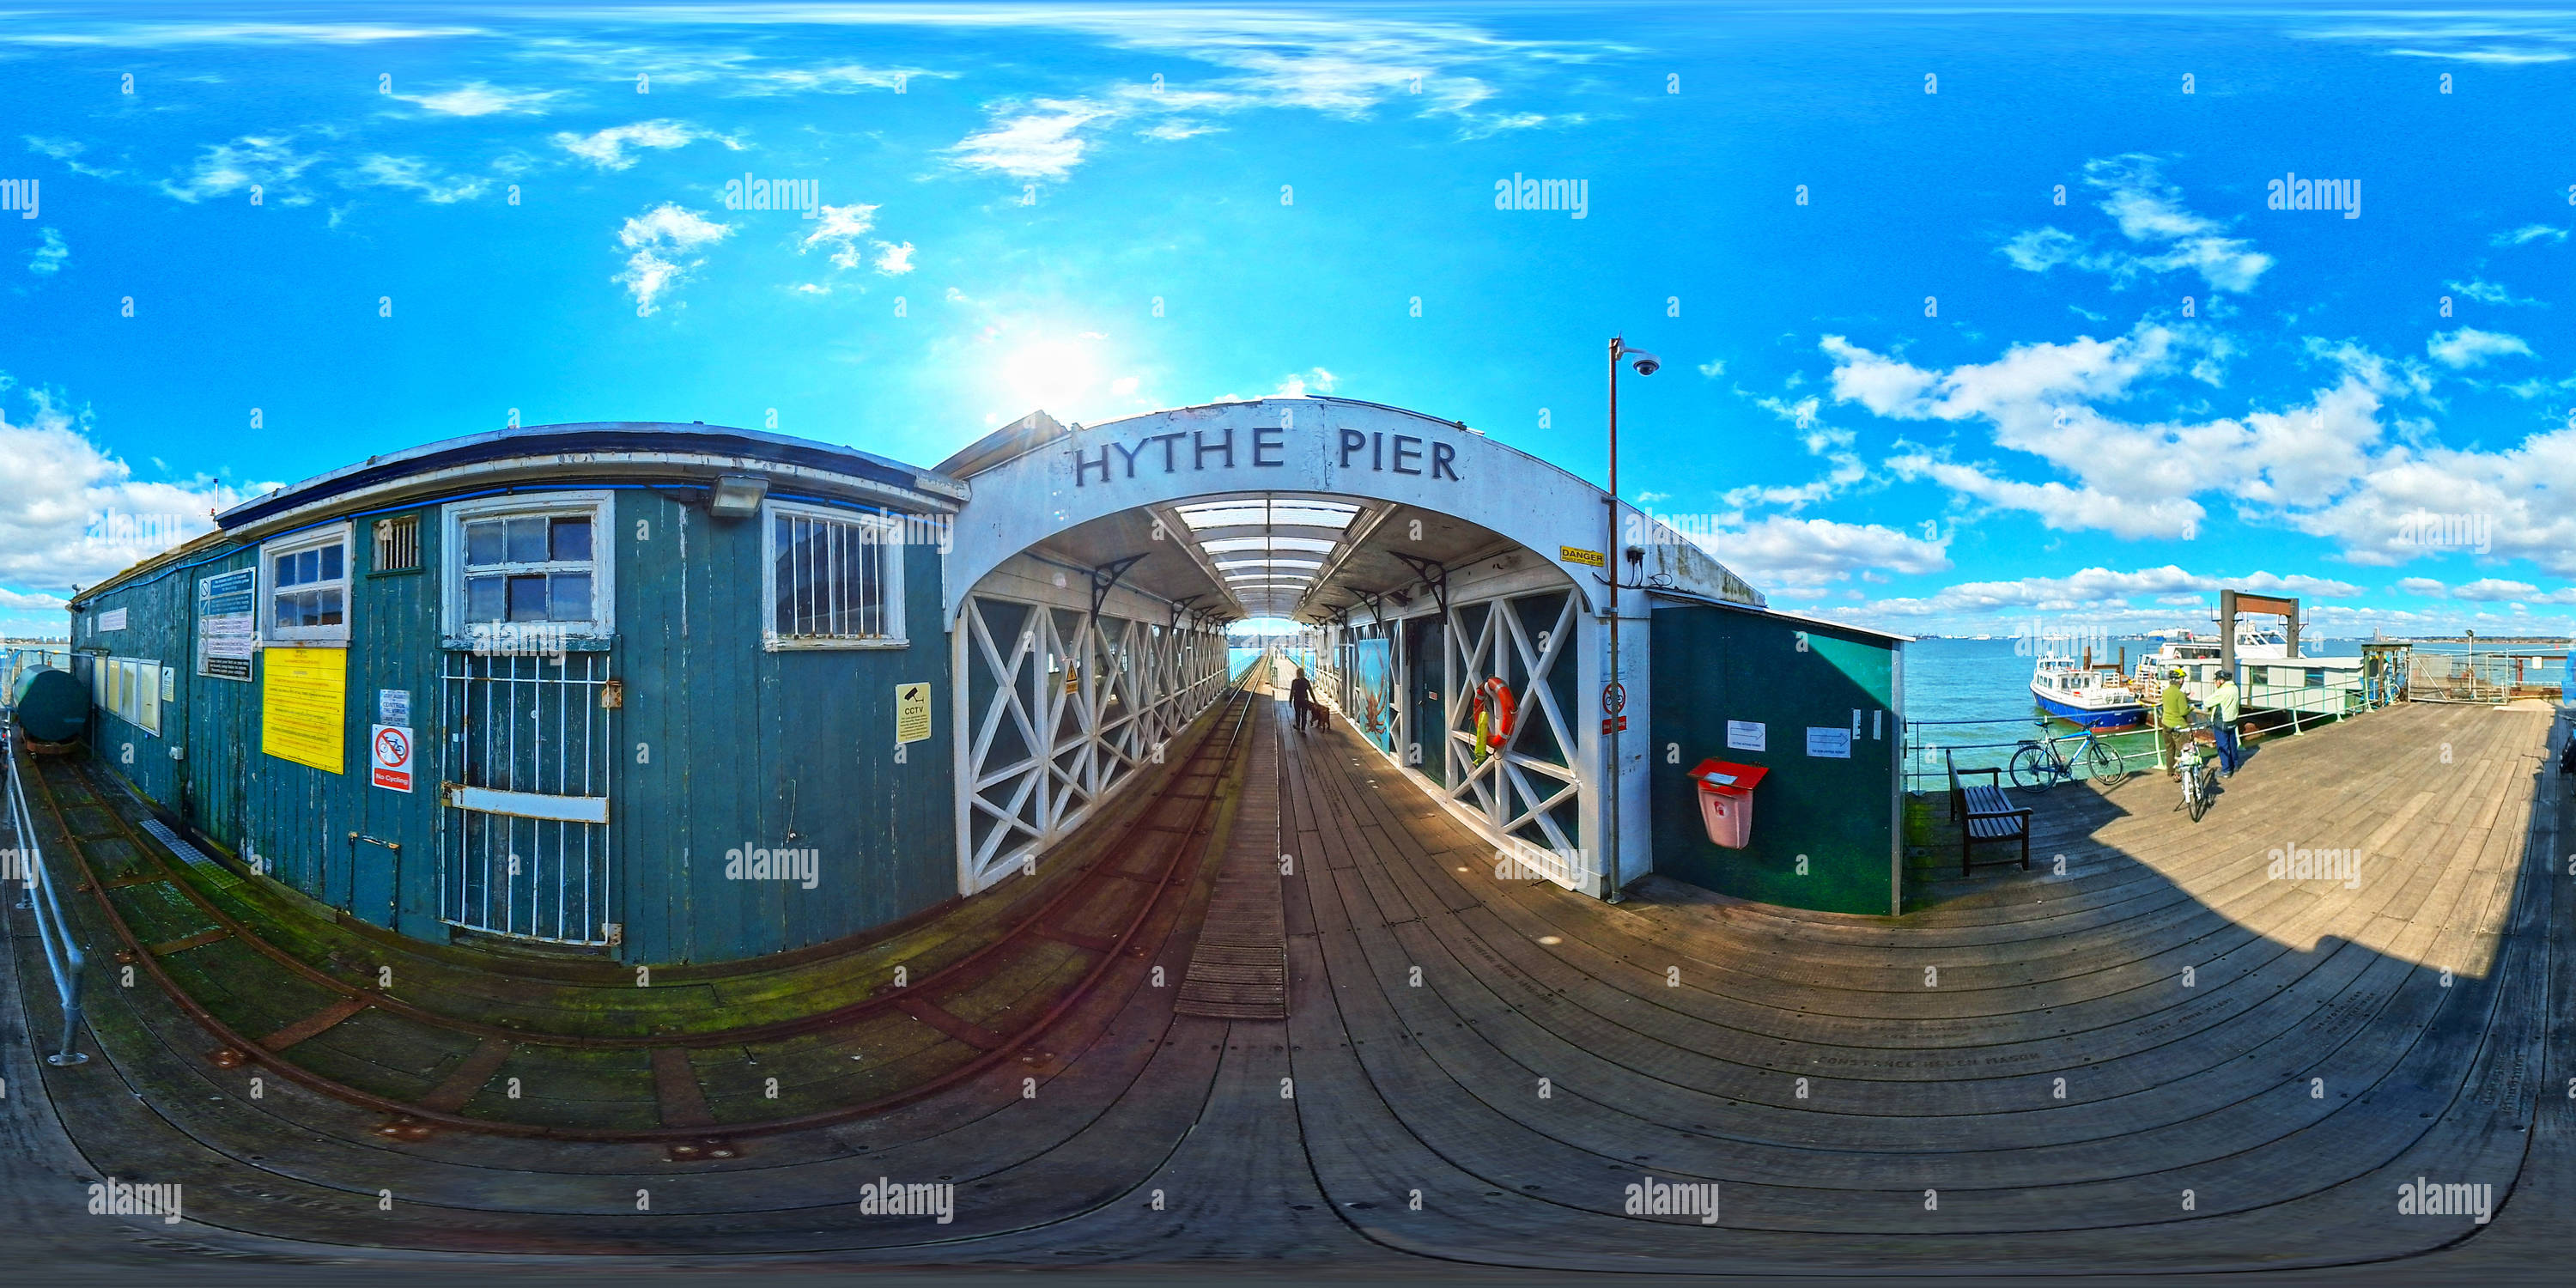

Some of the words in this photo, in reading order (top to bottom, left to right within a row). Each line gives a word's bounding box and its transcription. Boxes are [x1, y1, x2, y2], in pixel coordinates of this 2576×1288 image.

[1073, 427, 1285, 487] HYTHE
[1339, 427, 1460, 483] PIER
[1562, 549, 1603, 562] DANGER
[904, 706, 924, 715] CCTV
[385, 774, 409, 786] Cycling
[1818, 1055, 1916, 1069] CONSTANCE
[1923, 1058, 1978, 1068] HELEN
[1984, 1052, 2040, 1066] MASON
